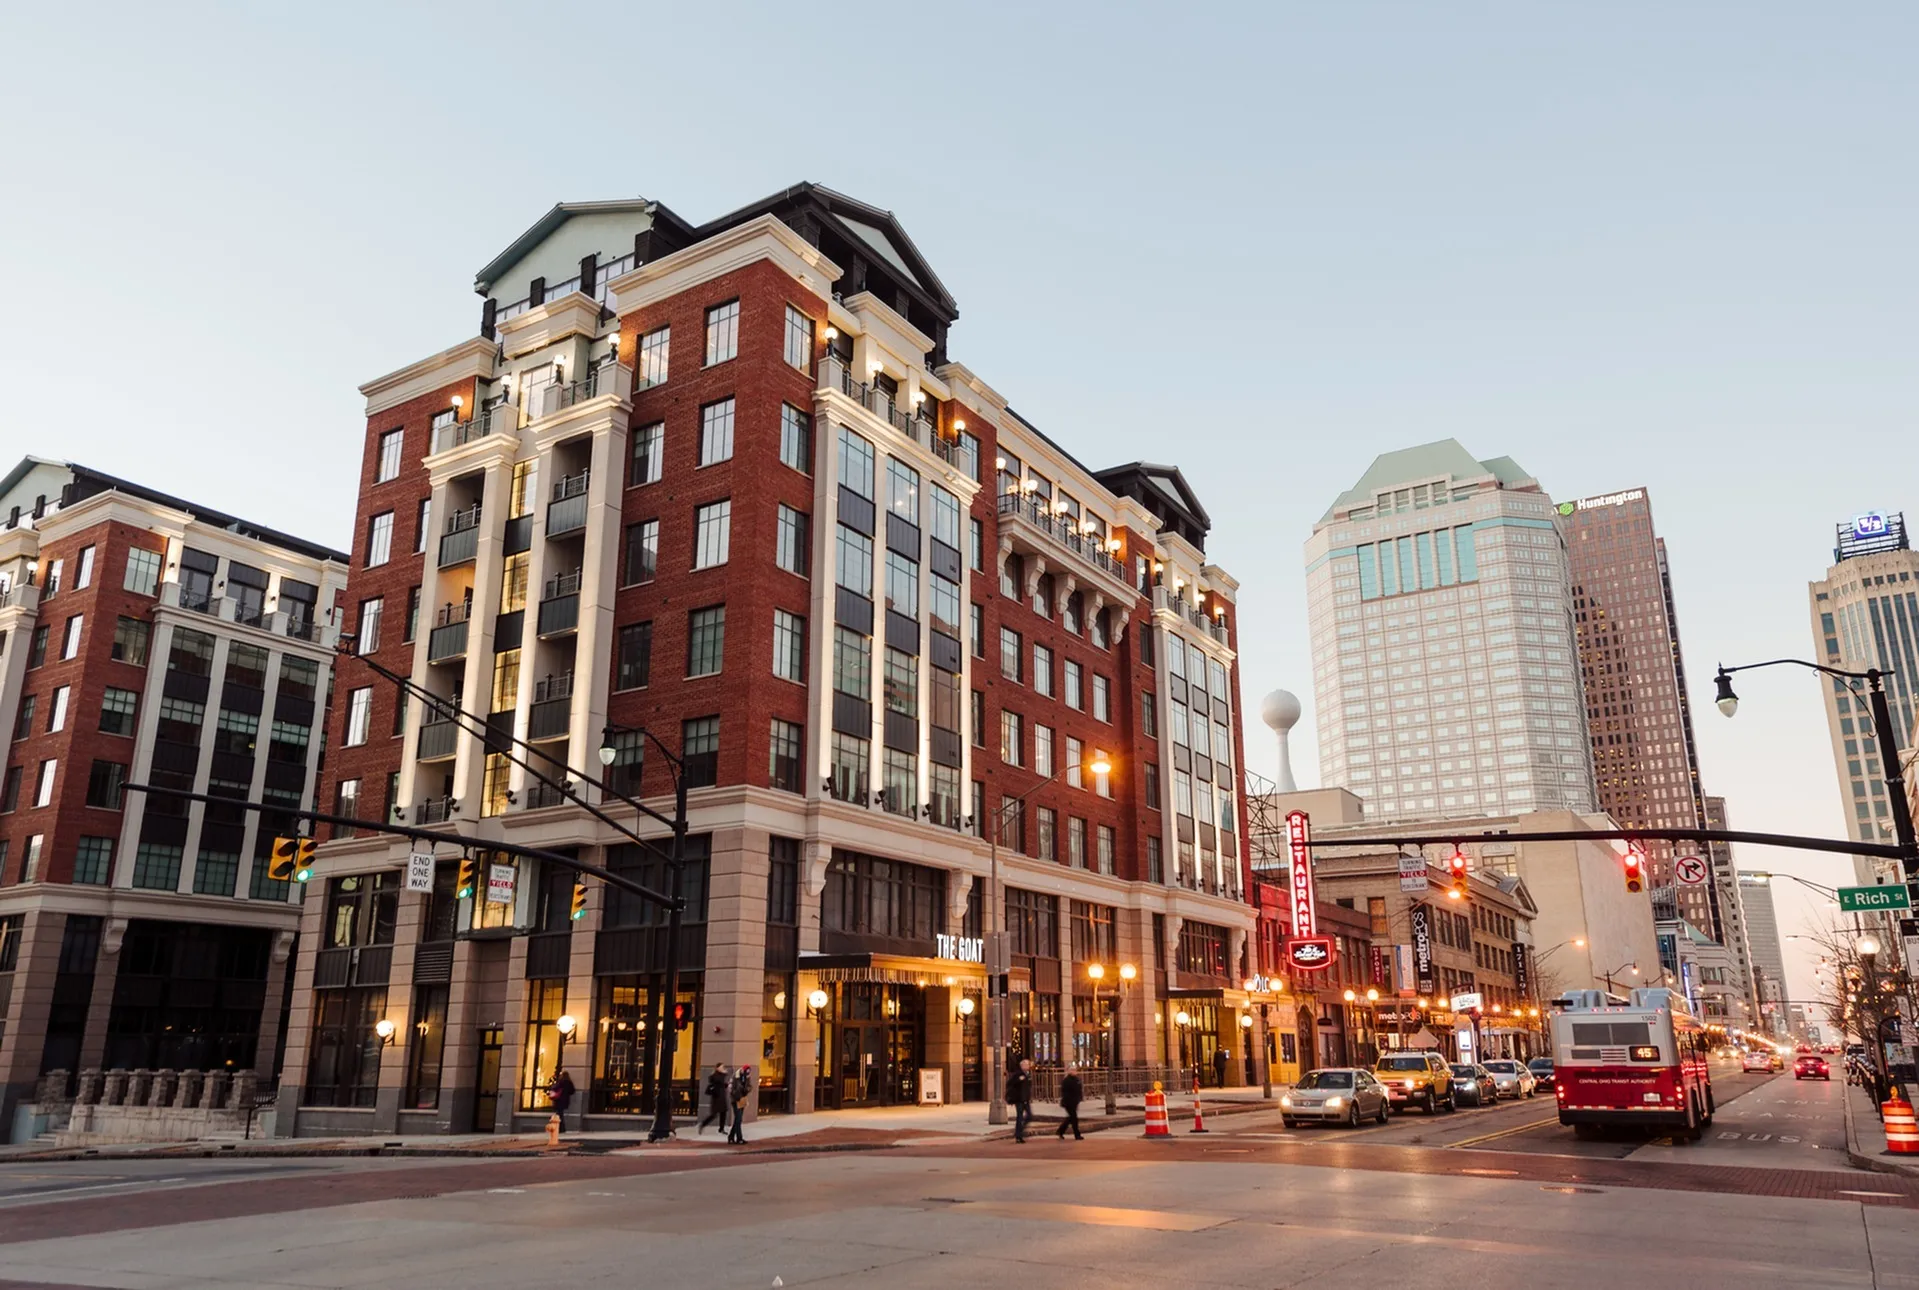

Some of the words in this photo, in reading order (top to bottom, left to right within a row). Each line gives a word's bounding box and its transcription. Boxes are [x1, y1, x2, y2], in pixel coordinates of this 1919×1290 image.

[1577, 490, 1643, 510] Huntington
[413, 855, 430, 866] END
[412, 866, 429, 877] ONE
[411, 879, 428, 888] WAY
[1855, 892, 1890, 905] Rich
[1413, 911, 1428, 972] metroPCS
[936, 933, 956, 960] THE
[958, 936, 984, 963] GOAT
[1638, 1047, 1652, 1058] 45
[1717, 1131, 1801, 1143] BUS
